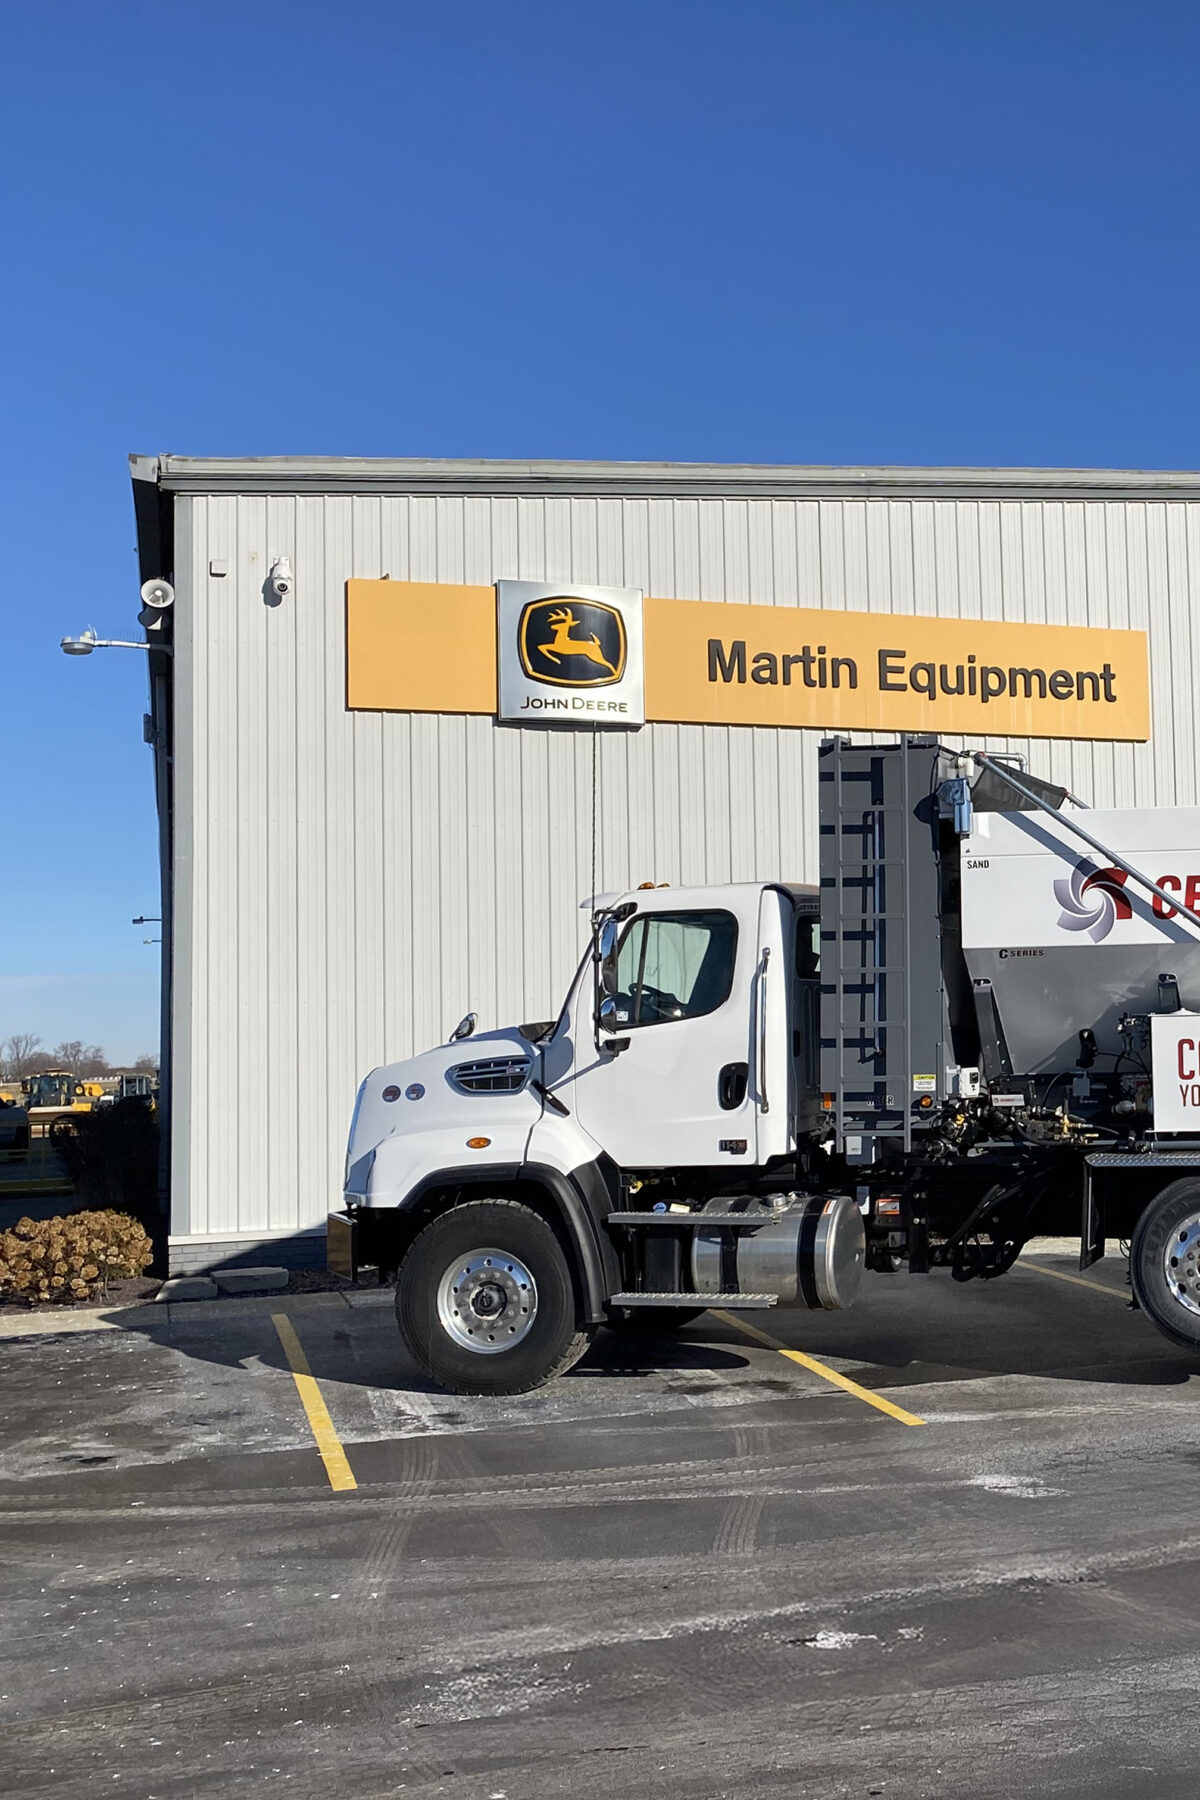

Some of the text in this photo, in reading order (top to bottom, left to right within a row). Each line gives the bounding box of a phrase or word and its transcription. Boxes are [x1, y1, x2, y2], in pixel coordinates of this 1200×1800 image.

[708, 639, 1117, 703] Martin Equipment
[520, 696, 628, 712] JOHN DEERE
[967, 860, 989, 869] SAND
[1010, 949, 1044, 958] SERIES
